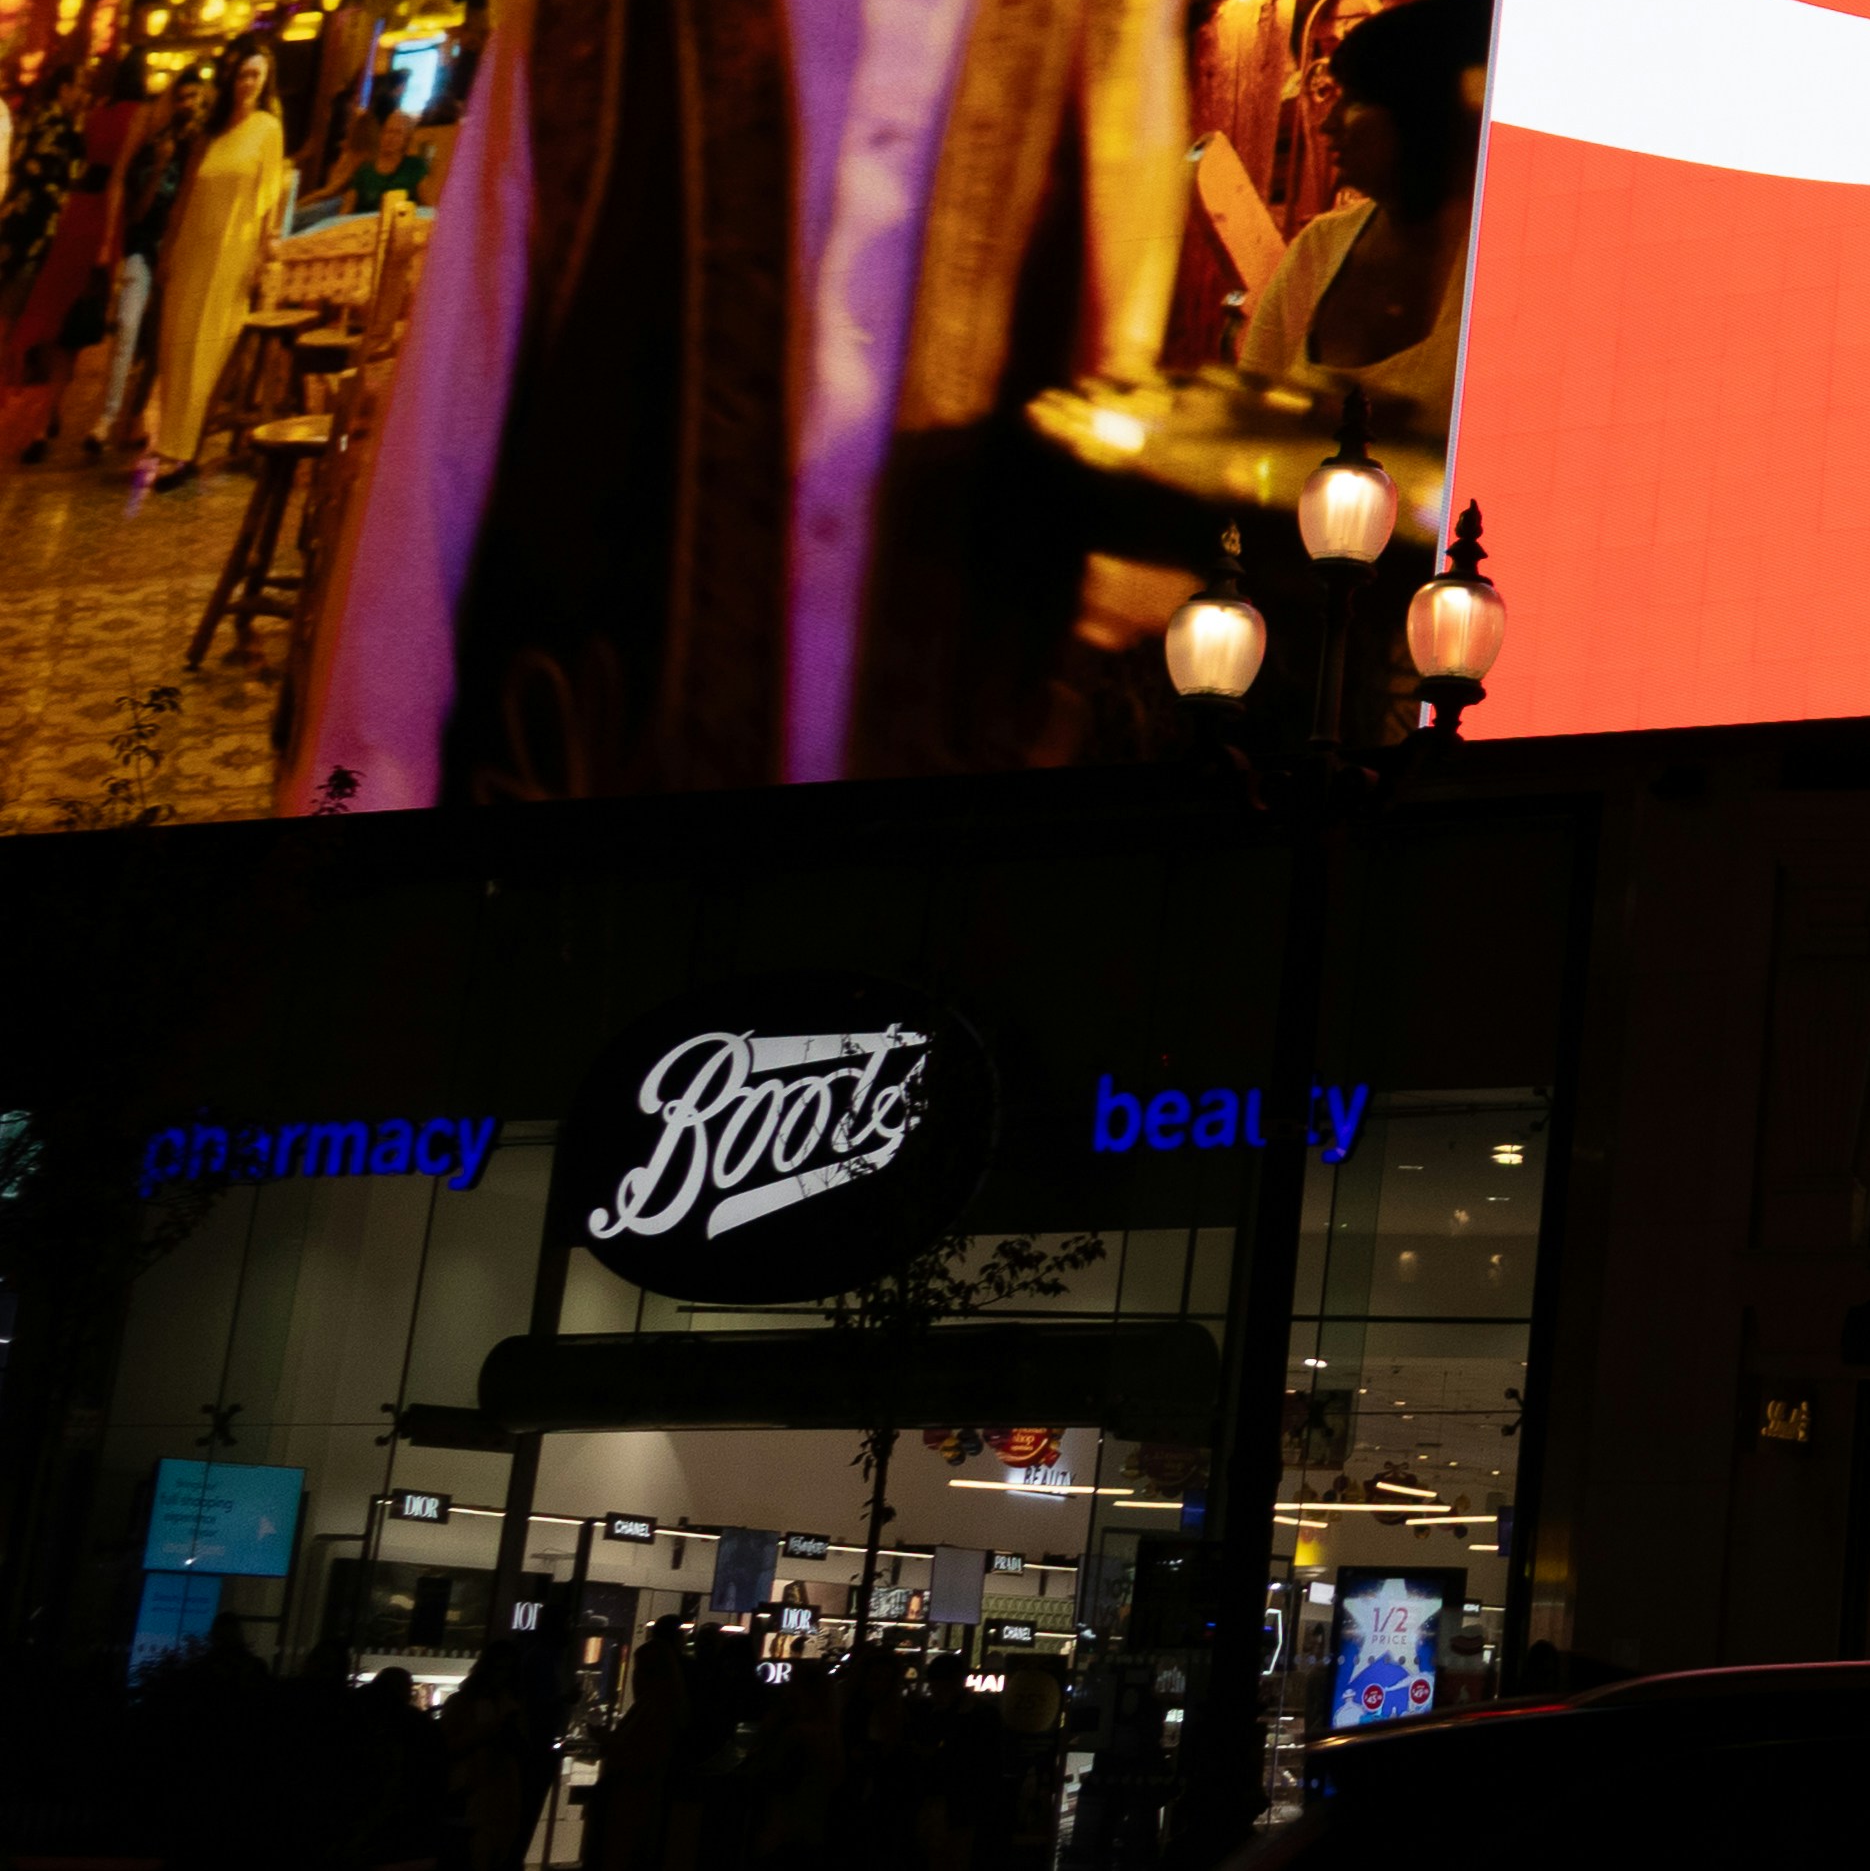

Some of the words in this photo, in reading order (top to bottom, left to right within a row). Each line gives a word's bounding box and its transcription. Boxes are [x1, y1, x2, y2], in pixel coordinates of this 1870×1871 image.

[588, 1022, 933, 1240] Boots
[136, 1114, 499, 1200] pharmacy
[402, 1493, 440, 1520] DIOR
[613, 1519, 652, 1538] CHANEL
[993, 1555, 1023, 1573] PRADA
[781, 1607, 812, 1633] DIOR
[1372, 1606, 1410, 1634] 1/2
[1001, 1625, 1033, 1642] CHANEL
[1370, 1633, 1408, 1646] PRICE
